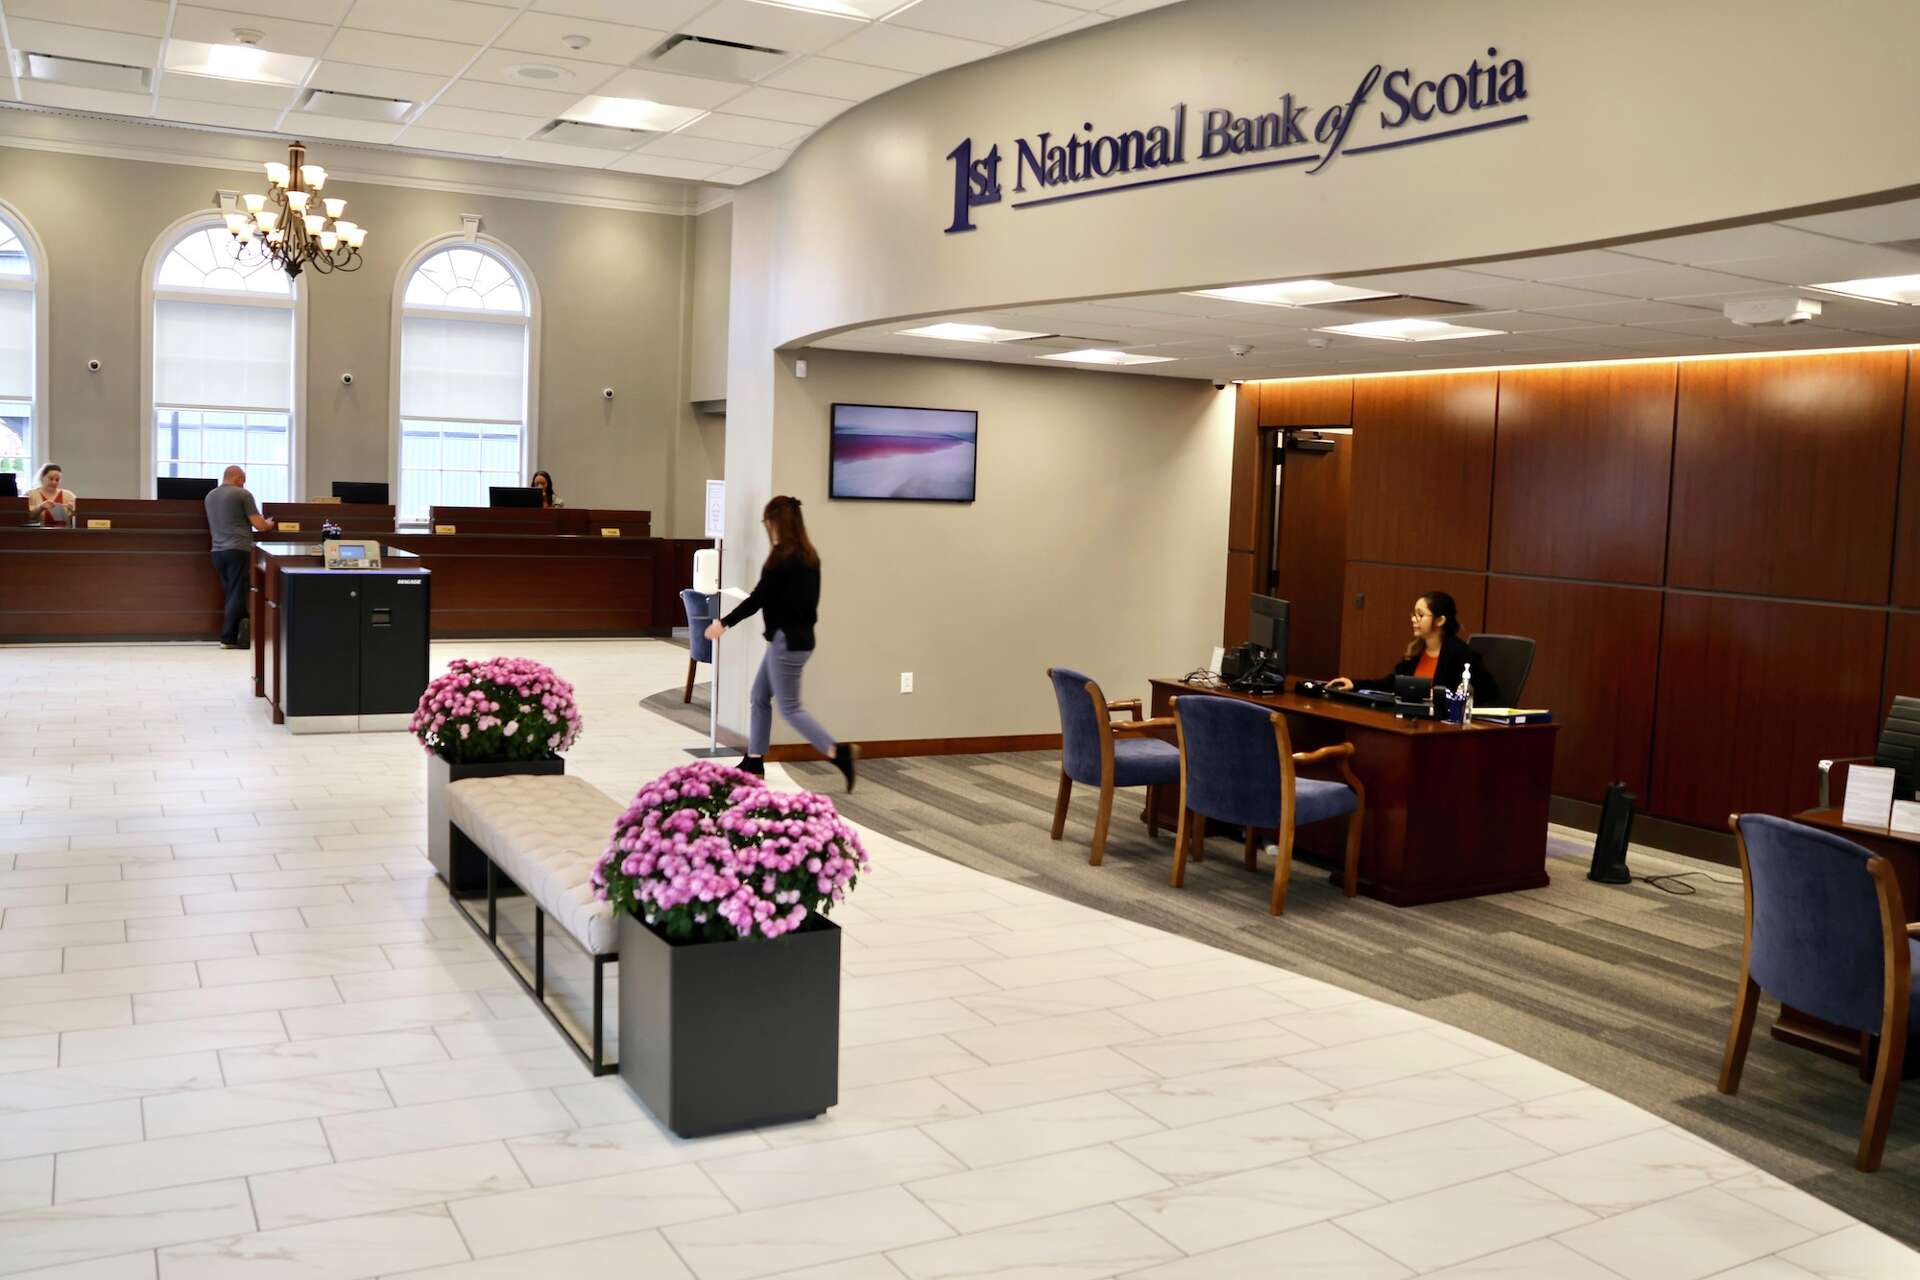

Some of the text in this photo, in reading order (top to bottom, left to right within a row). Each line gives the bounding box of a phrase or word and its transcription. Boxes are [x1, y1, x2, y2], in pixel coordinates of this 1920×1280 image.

[944, 47, 1527, 233] 1st National Bank of Scotia
